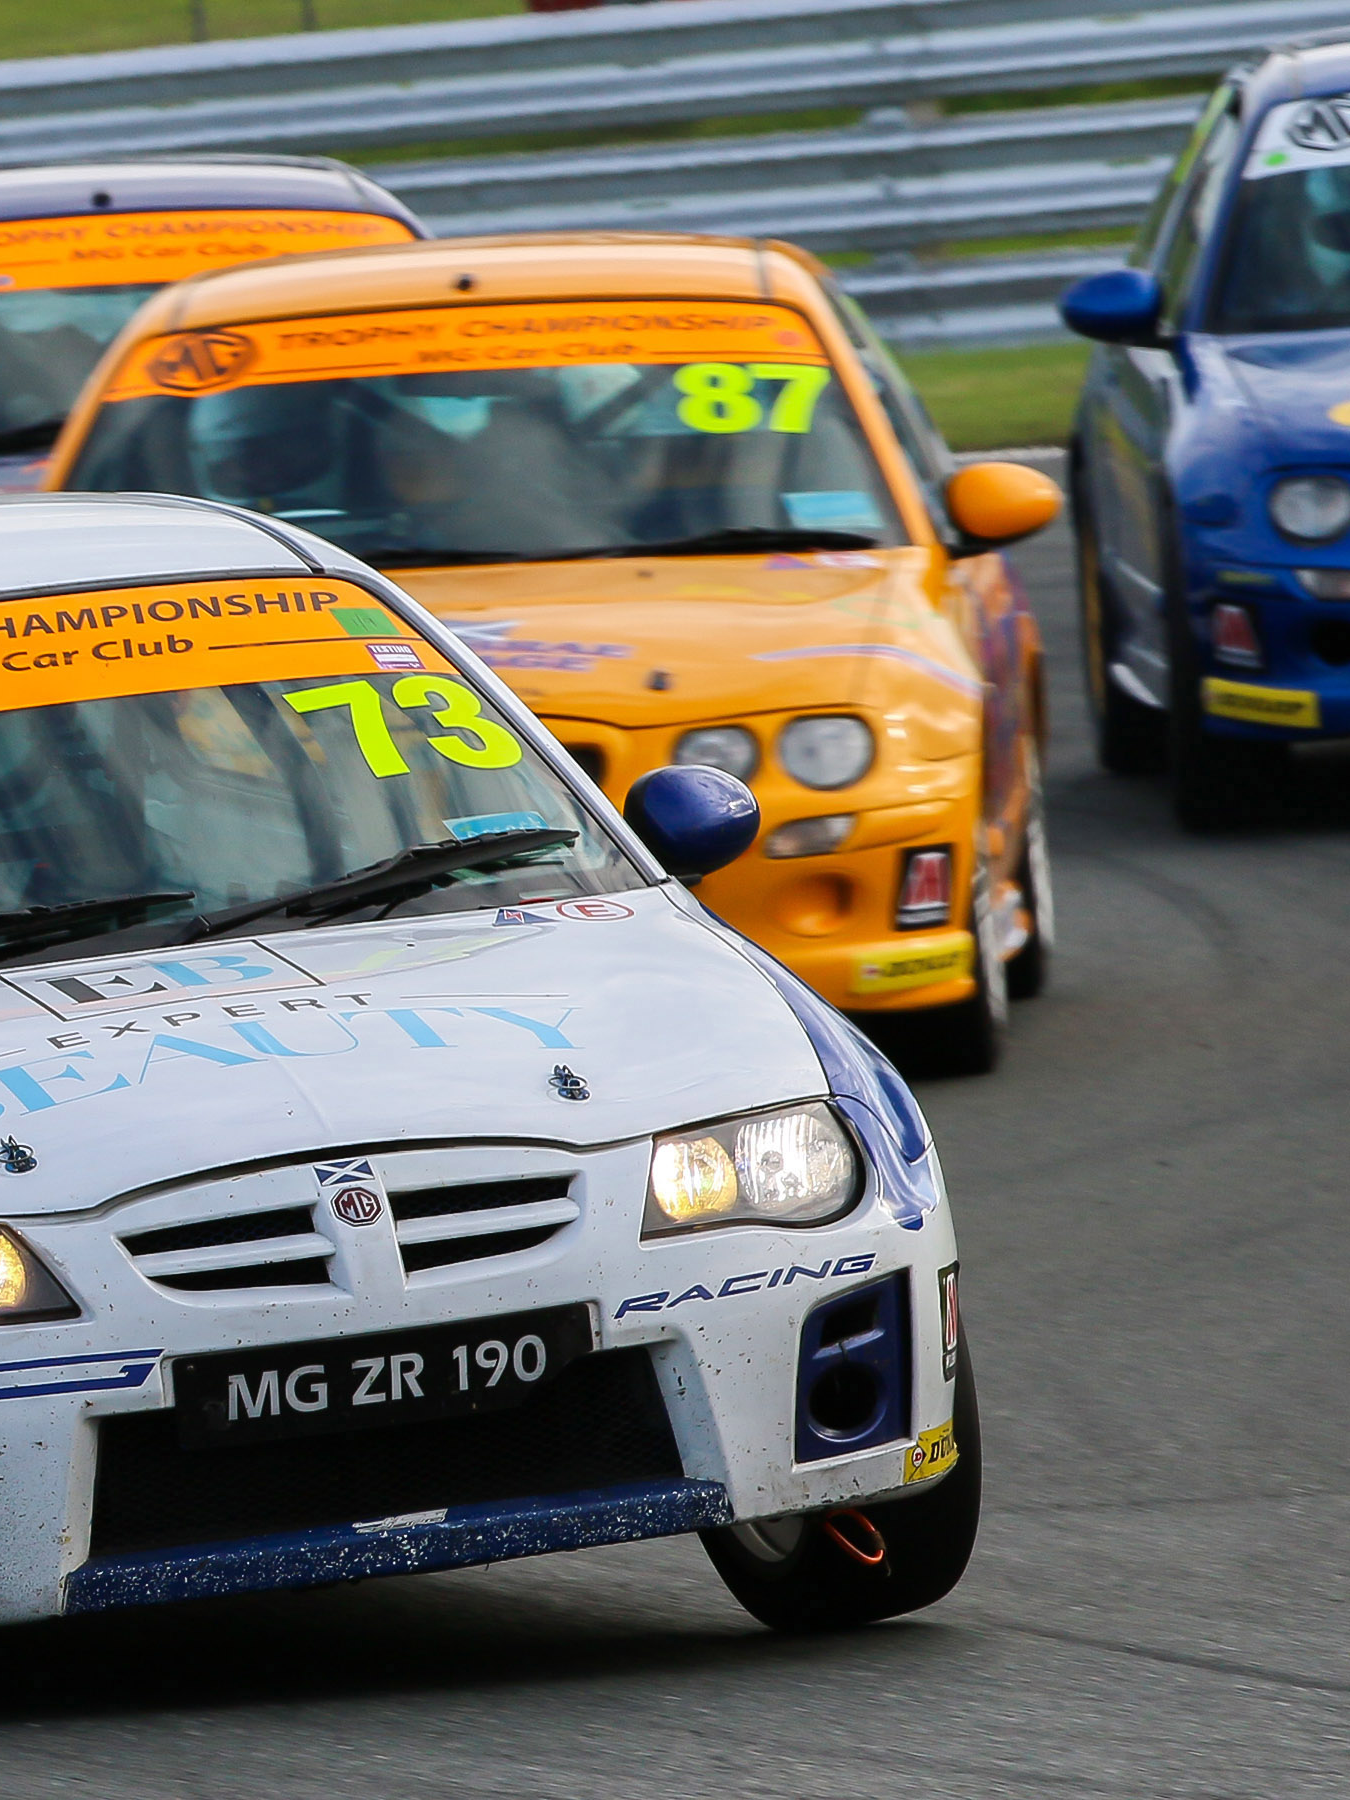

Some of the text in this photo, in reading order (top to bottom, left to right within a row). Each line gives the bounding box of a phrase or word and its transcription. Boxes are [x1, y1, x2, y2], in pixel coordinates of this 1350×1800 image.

[672, 361, 831, 434] 87
[1, 649, 79, 672] Car
[90, 634, 194, 661] Club
[281, 674, 524, 780] 73
[44, 954, 275, 1006] EB
[47, 993, 372, 1050] EXPERT
[613, 1252, 877, 1321] RACING
[227, 1334, 547, 1421] MG ZR 190
